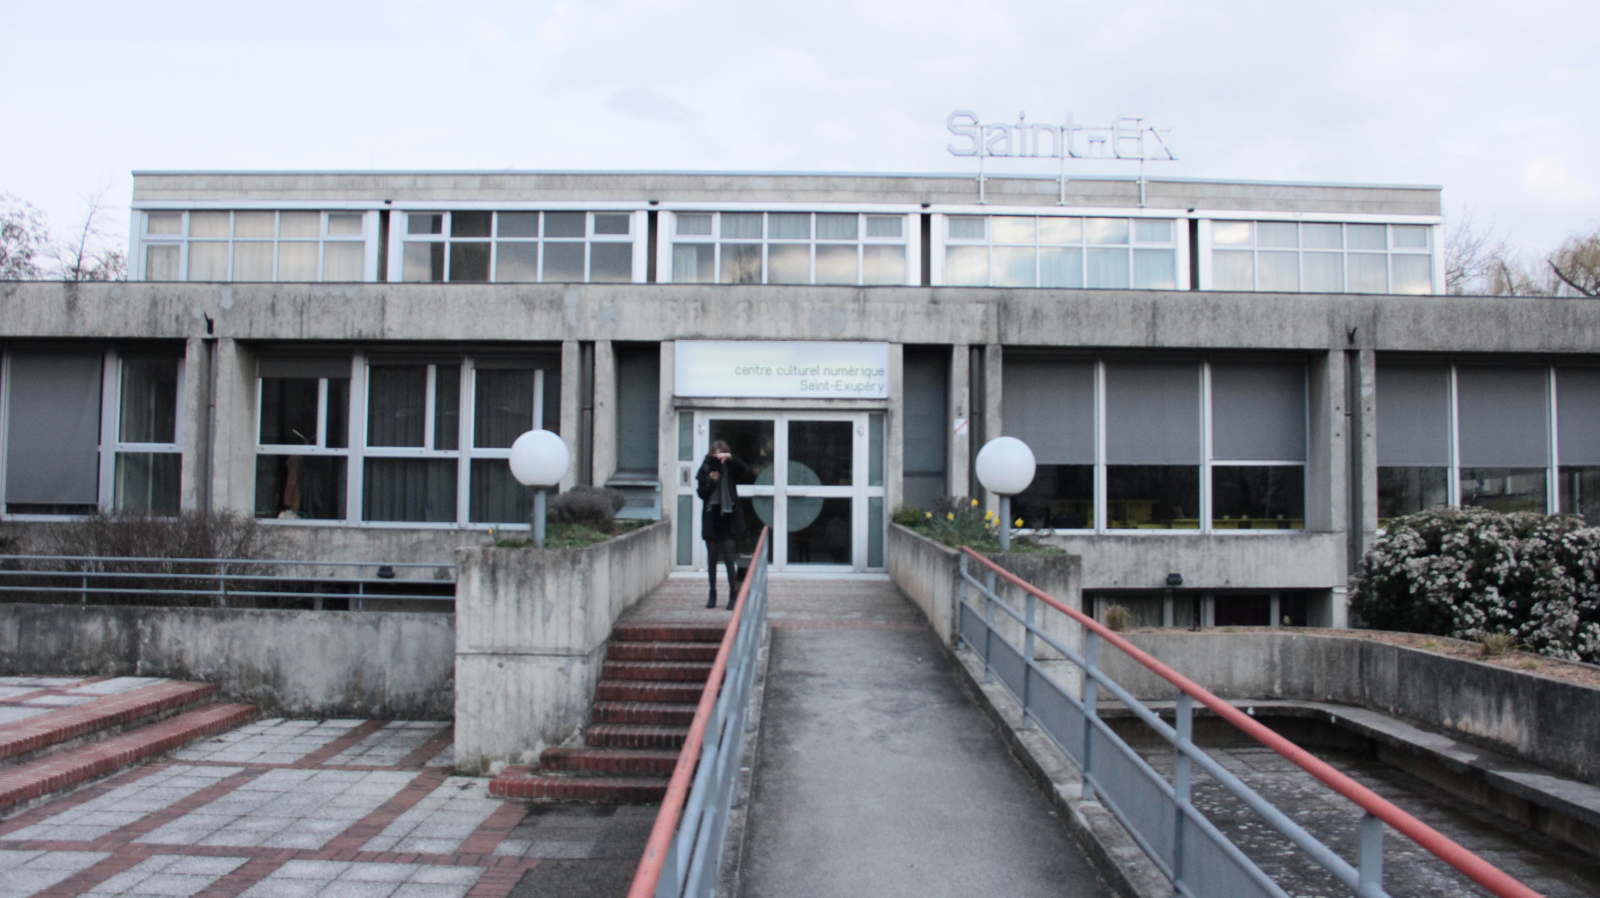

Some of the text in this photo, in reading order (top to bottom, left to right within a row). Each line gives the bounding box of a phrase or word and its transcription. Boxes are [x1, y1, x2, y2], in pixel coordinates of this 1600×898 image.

[946, 110, 1179, 161] Saint-Ex
[735, 364, 885, 380] centre culturel numérique
[800, 380, 884, 393] Saint-Exupéry
